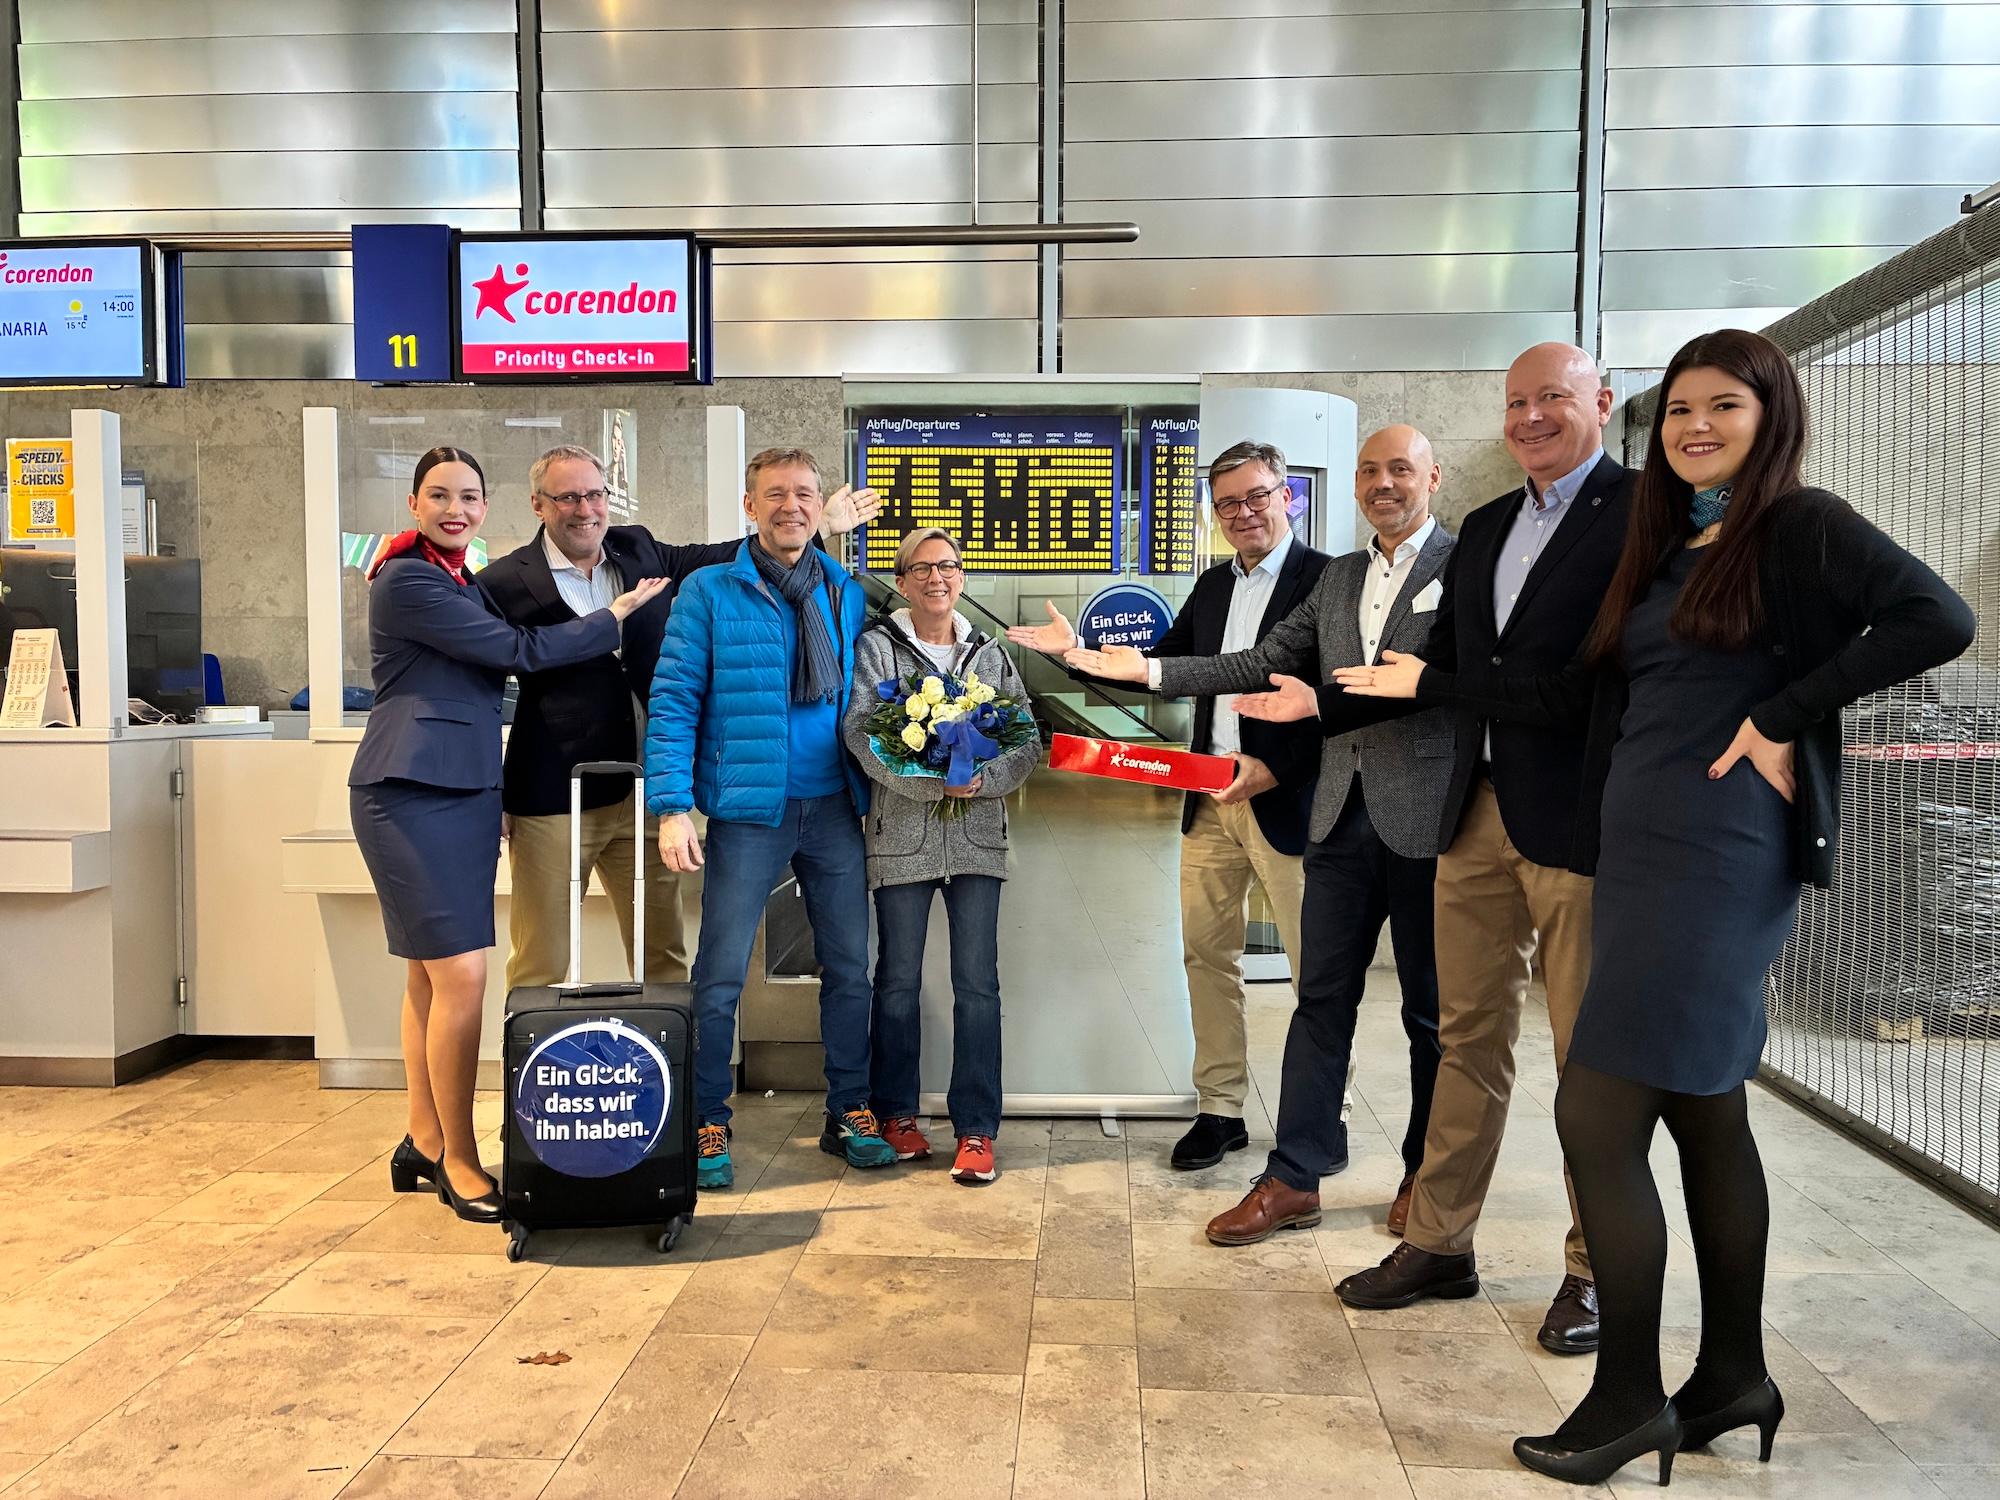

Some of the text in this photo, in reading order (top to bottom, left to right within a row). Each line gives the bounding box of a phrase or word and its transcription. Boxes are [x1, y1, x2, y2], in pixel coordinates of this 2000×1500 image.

[5, 263, 94, 284] corendon
[525, 281, 678, 315] corendon
[103, 301, 135, 312] 14:00
[0, 321, 49, 337] NARIA
[66, 321, 76, 330] 15
[388, 334, 418, 368] 11
[495, 349, 655, 370] Priority Check-in
[866, 418, 961, 433] Abflug/Departures
[1155, 446, 1168, 454] TK
[1155, 456, 1168, 465] AF
[1155, 467, 1168, 476] LH
[21, 474, 65, 485] CHECKS
[1155, 488, 1168, 497] LH
[1172, 499, 1194, 509] 6422
[1155, 520, 1168, 529] LH
[1155, 541, 1168, 550] LH
[1091, 615, 1112, 629] Ein
[1097, 627, 1153, 644] dass wir
[1122, 758, 1172, 773] corendon
[536, 1065, 570, 1086] Ein
[545, 1091, 636, 1113] dass wir
[536, 1119, 650, 1141] ihn haben.
